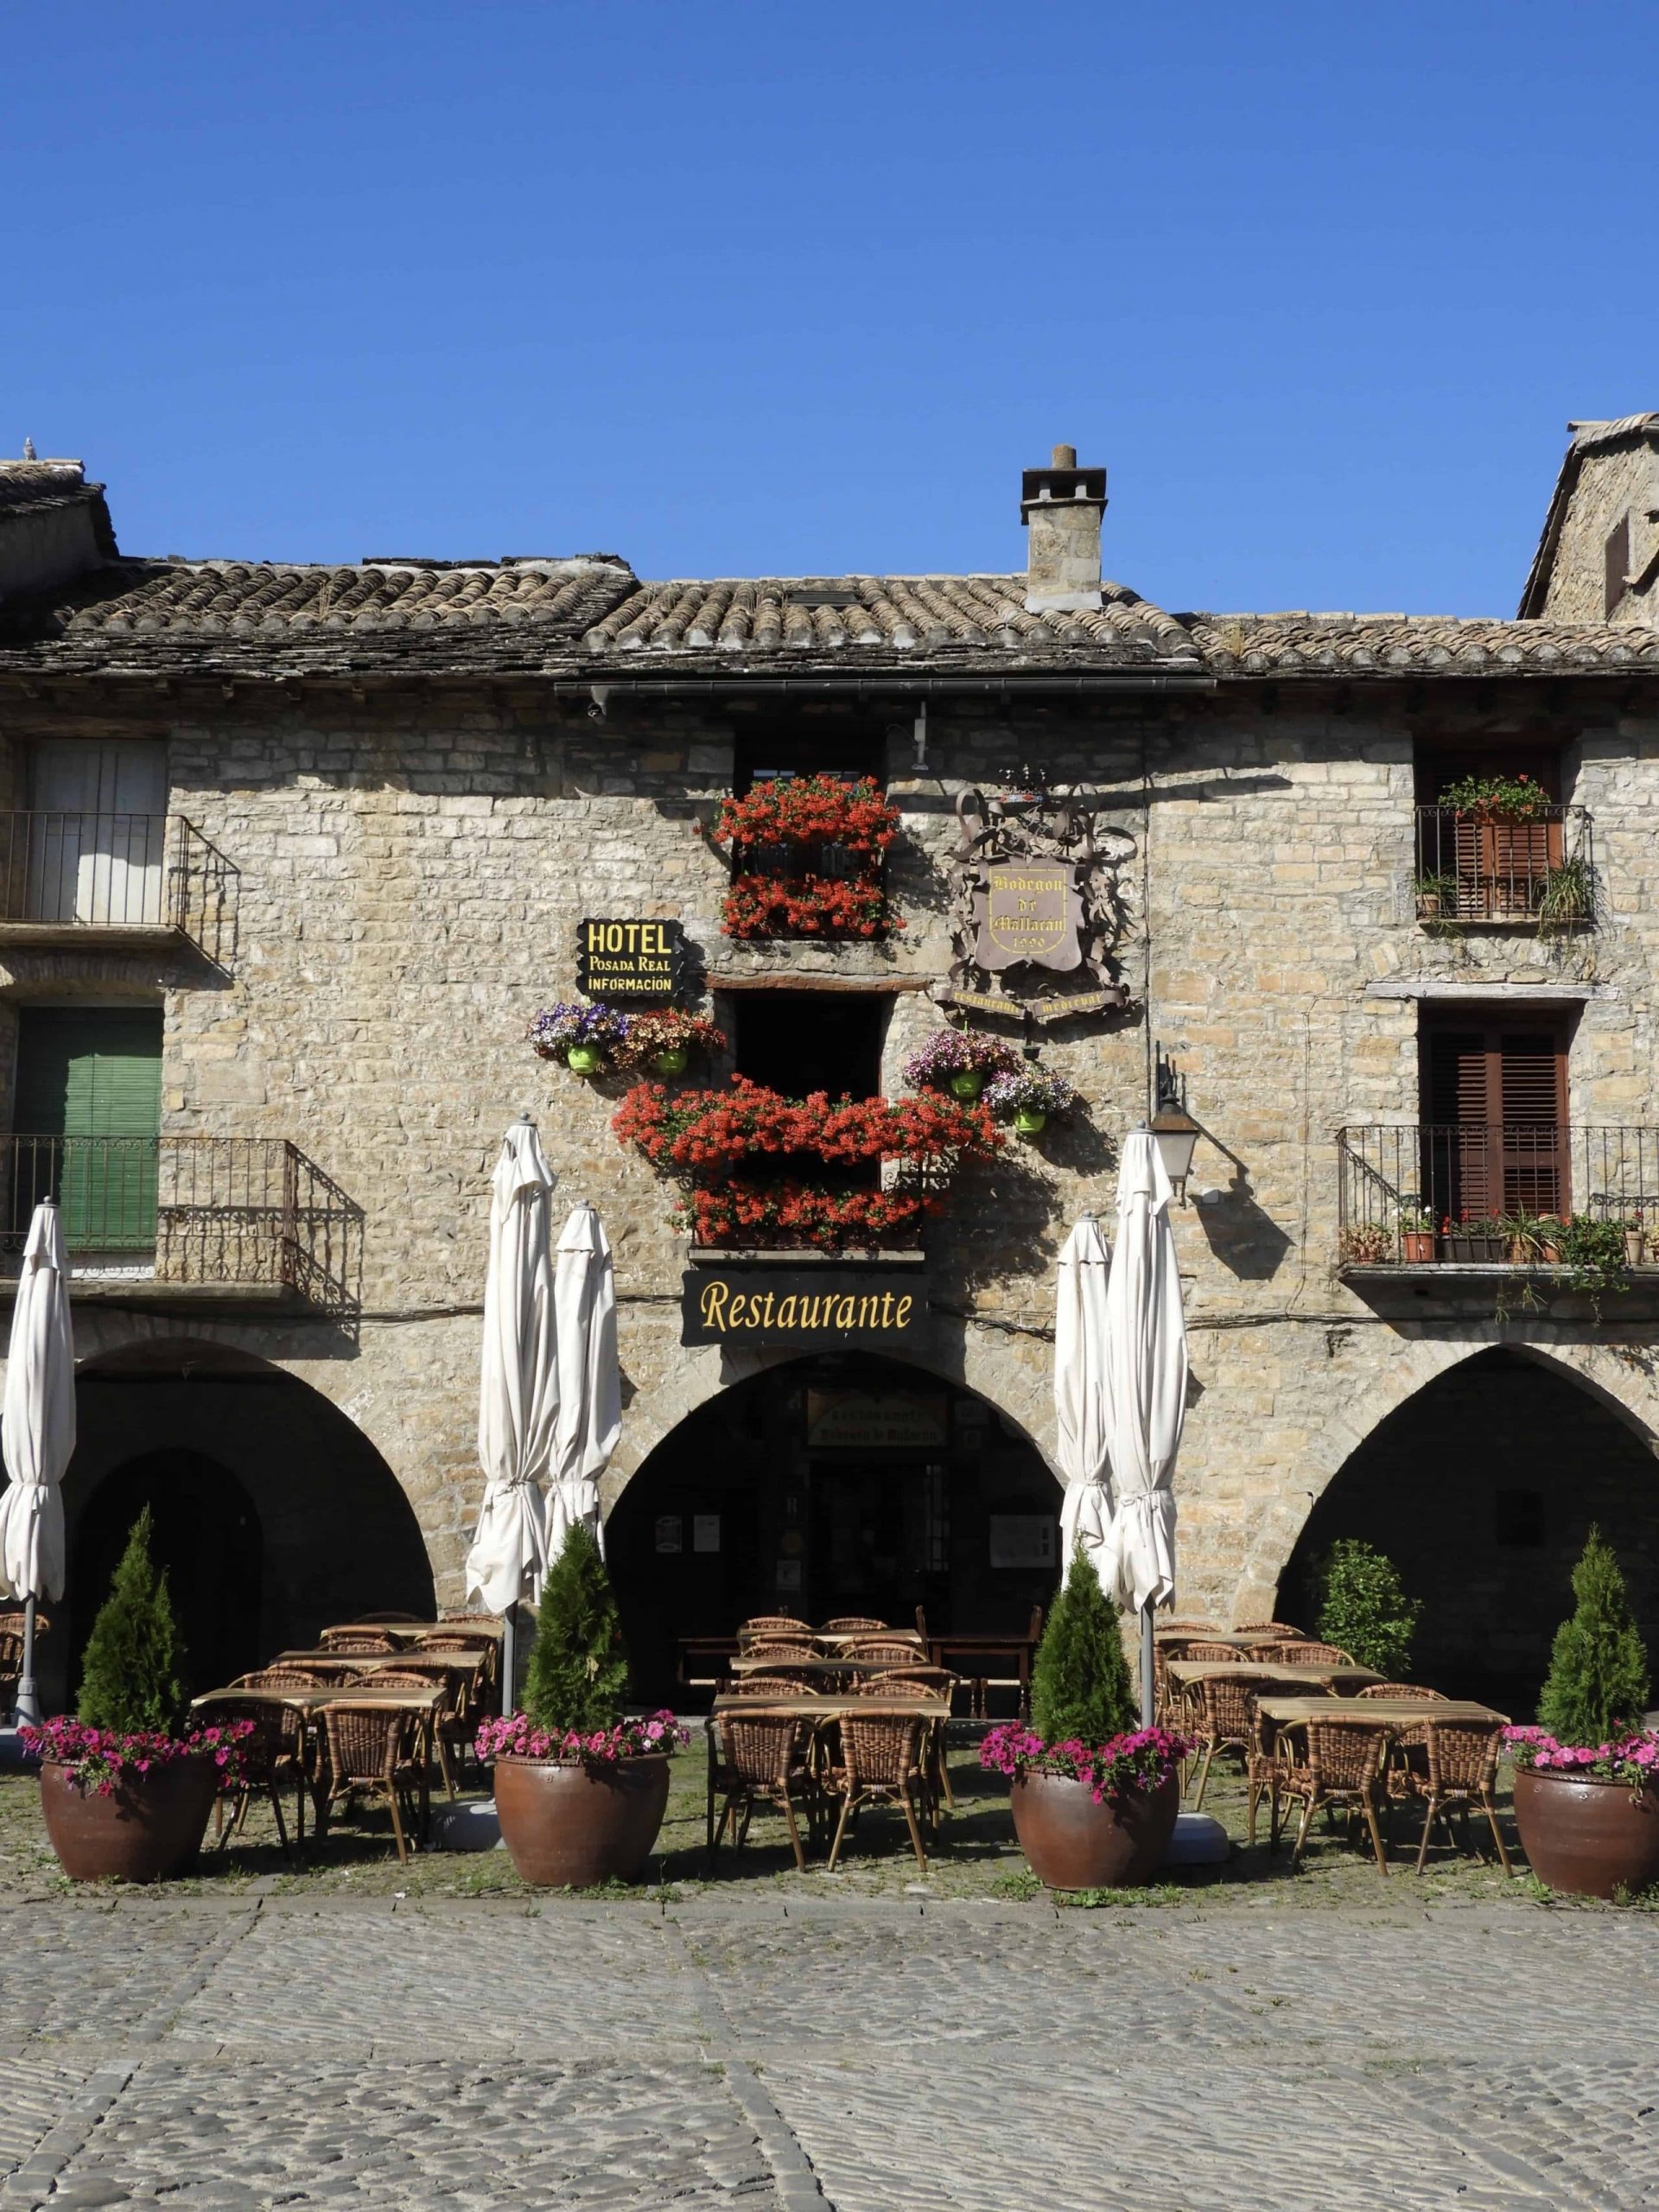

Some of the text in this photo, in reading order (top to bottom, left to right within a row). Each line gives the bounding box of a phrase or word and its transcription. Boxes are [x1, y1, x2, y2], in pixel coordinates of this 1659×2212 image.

[1017, 897, 1038, 912] de
[588, 923, 672, 954] HOTEL
[1012, 937, 1046, 949] 1990
[700, 1281, 912, 1332] Restaurante
